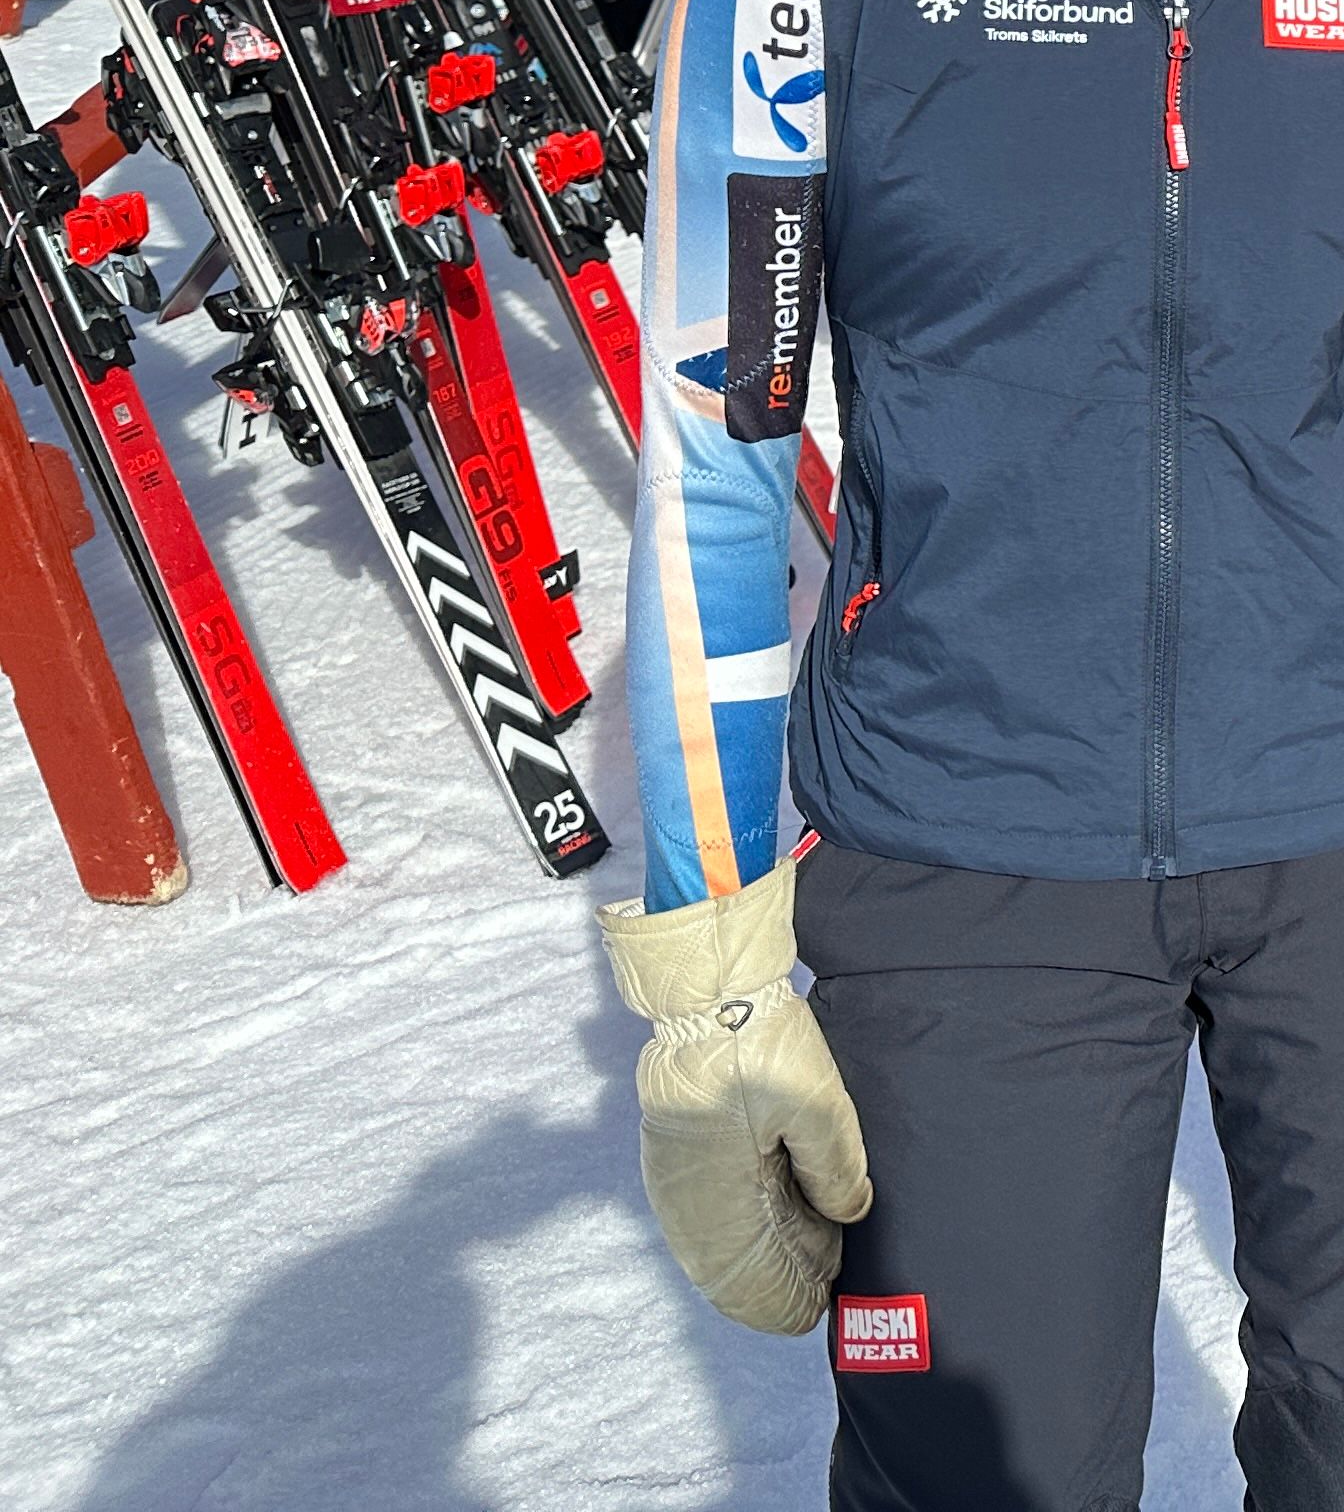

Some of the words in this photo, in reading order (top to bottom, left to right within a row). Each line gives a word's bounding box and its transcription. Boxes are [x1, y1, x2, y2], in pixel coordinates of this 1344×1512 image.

[984, 27, 1028, 42] Troms
[1032, 29, 1088, 44] Skikrets
[1171, 124, 1189, 165] HUSKI
[765, 206, 804, 411] re:member
[602, 326, 633, 348] 192
[534, 789, 586, 844] 25
[843, 1307, 917, 1340] HUSKI
[843, 1343, 919, 1361] WEAR
